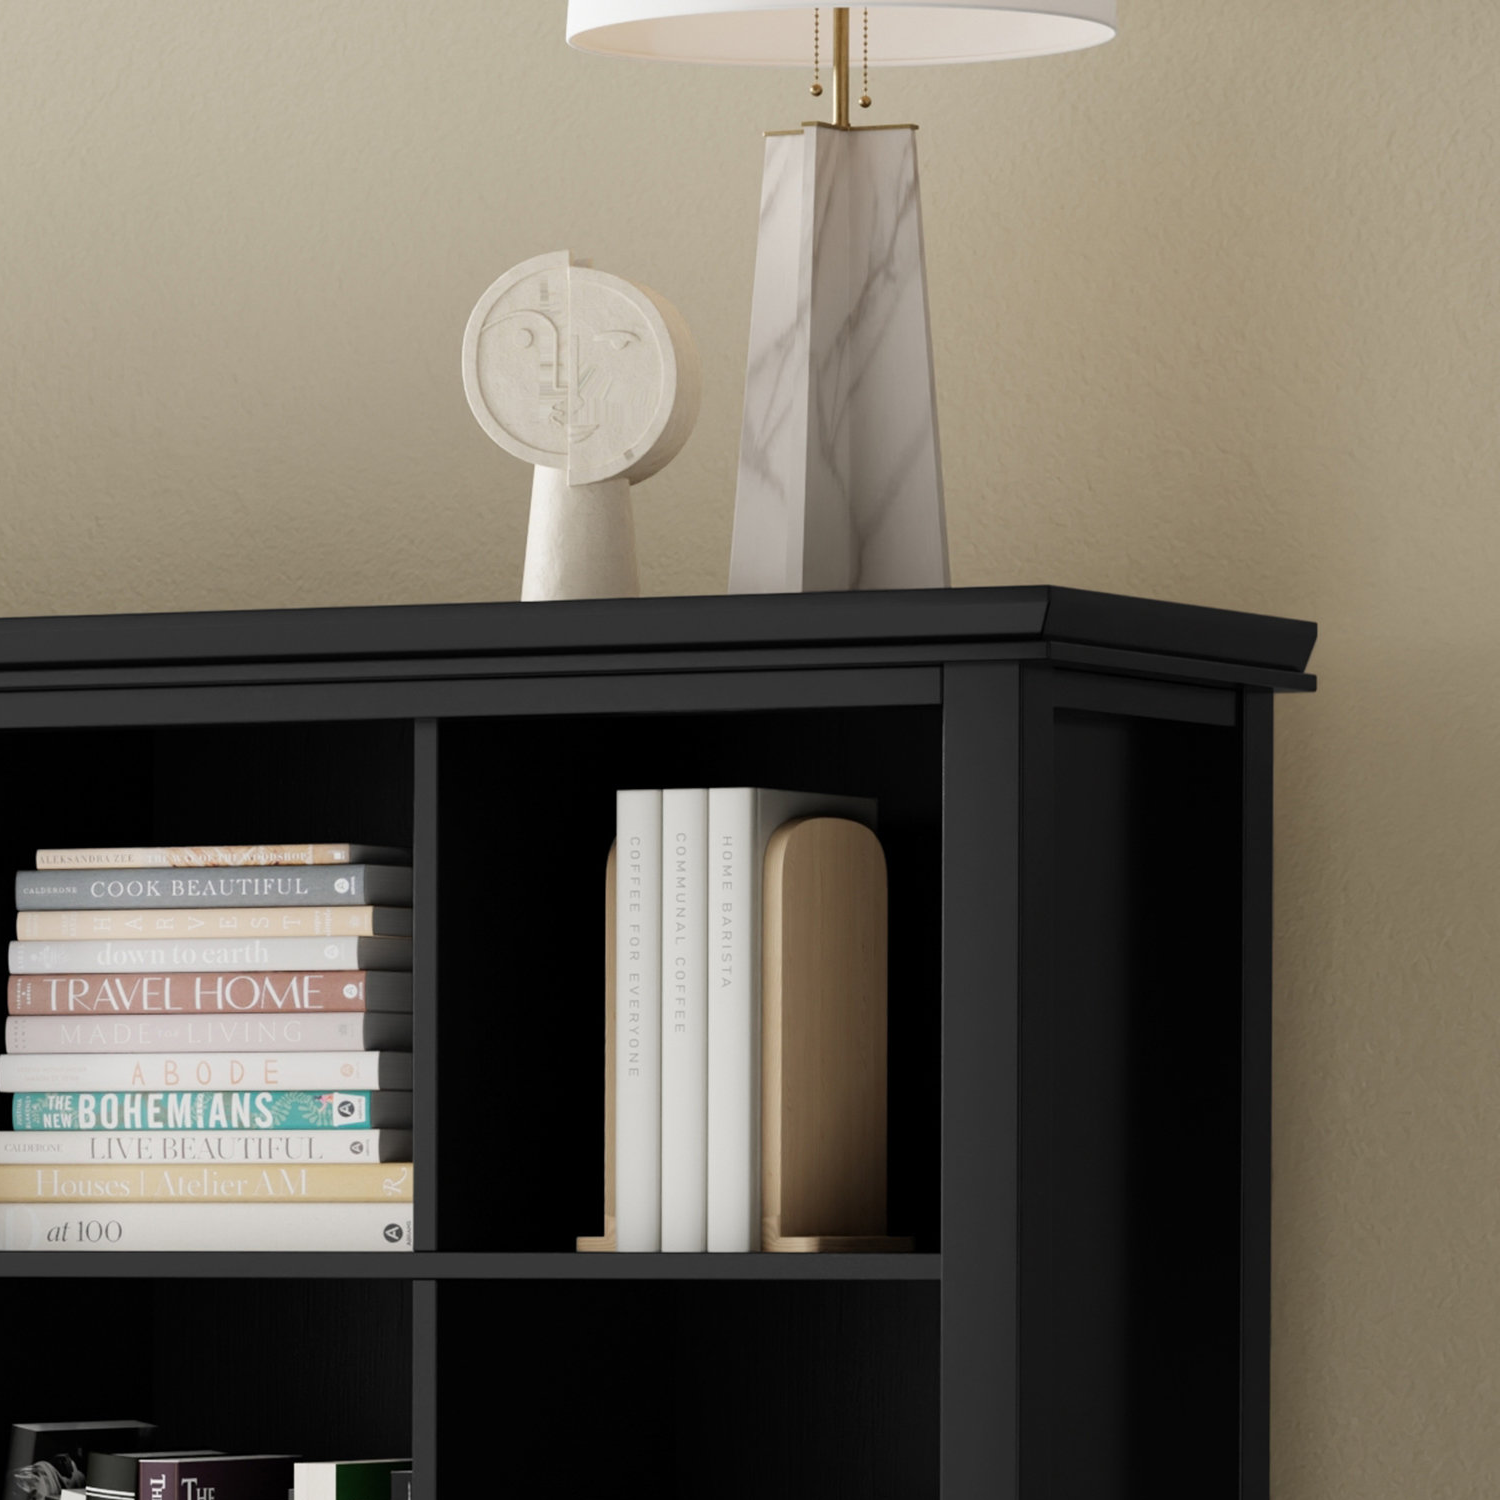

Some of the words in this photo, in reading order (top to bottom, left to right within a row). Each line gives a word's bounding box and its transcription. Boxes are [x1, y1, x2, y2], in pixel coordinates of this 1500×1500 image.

[628, 835, 641, 914] COFFEE
[721, 835, 733, 892] HOME
[22, 886, 78, 895] CALDERONE
[90, 880, 160, 898] COOK
[171, 877, 308, 897] BEAUTIFUL
[675, 832, 687, 946] COMMUNAL
[97, 942, 165, 965] down
[172, 943, 197, 965] to
[202, 940, 269, 964] earth
[628, 923, 641, 961] FOR
[721, 902, 733, 989] BARISTA
[42, 977, 184, 1011] TRAVEL
[194, 974, 325, 1010] HOME
[674, 956, 687, 1034] COFFEE
[61, 1022, 152, 1044] MADE
[187, 1020, 302, 1044] LIVING
[627, 972, 641, 1078] EVERYONE
[48, 1095, 74, 1112] THE
[78, 1092, 273, 1129] BOHEMIANS
[43, 1112, 73, 1128] NEW
[4, 1143, 63, 1154] CALDERONE
[89, 1136, 153, 1160] LIVE
[162, 1136, 324, 1160] BEAUTIFUL
[35, 1169, 131, 1197] Houses
[156, 1168, 248, 1197] Atelier
[254, 1168, 309, 1197] AM
[46, 1221, 71, 1243] at
[74, 1219, 123, 1243] 100
